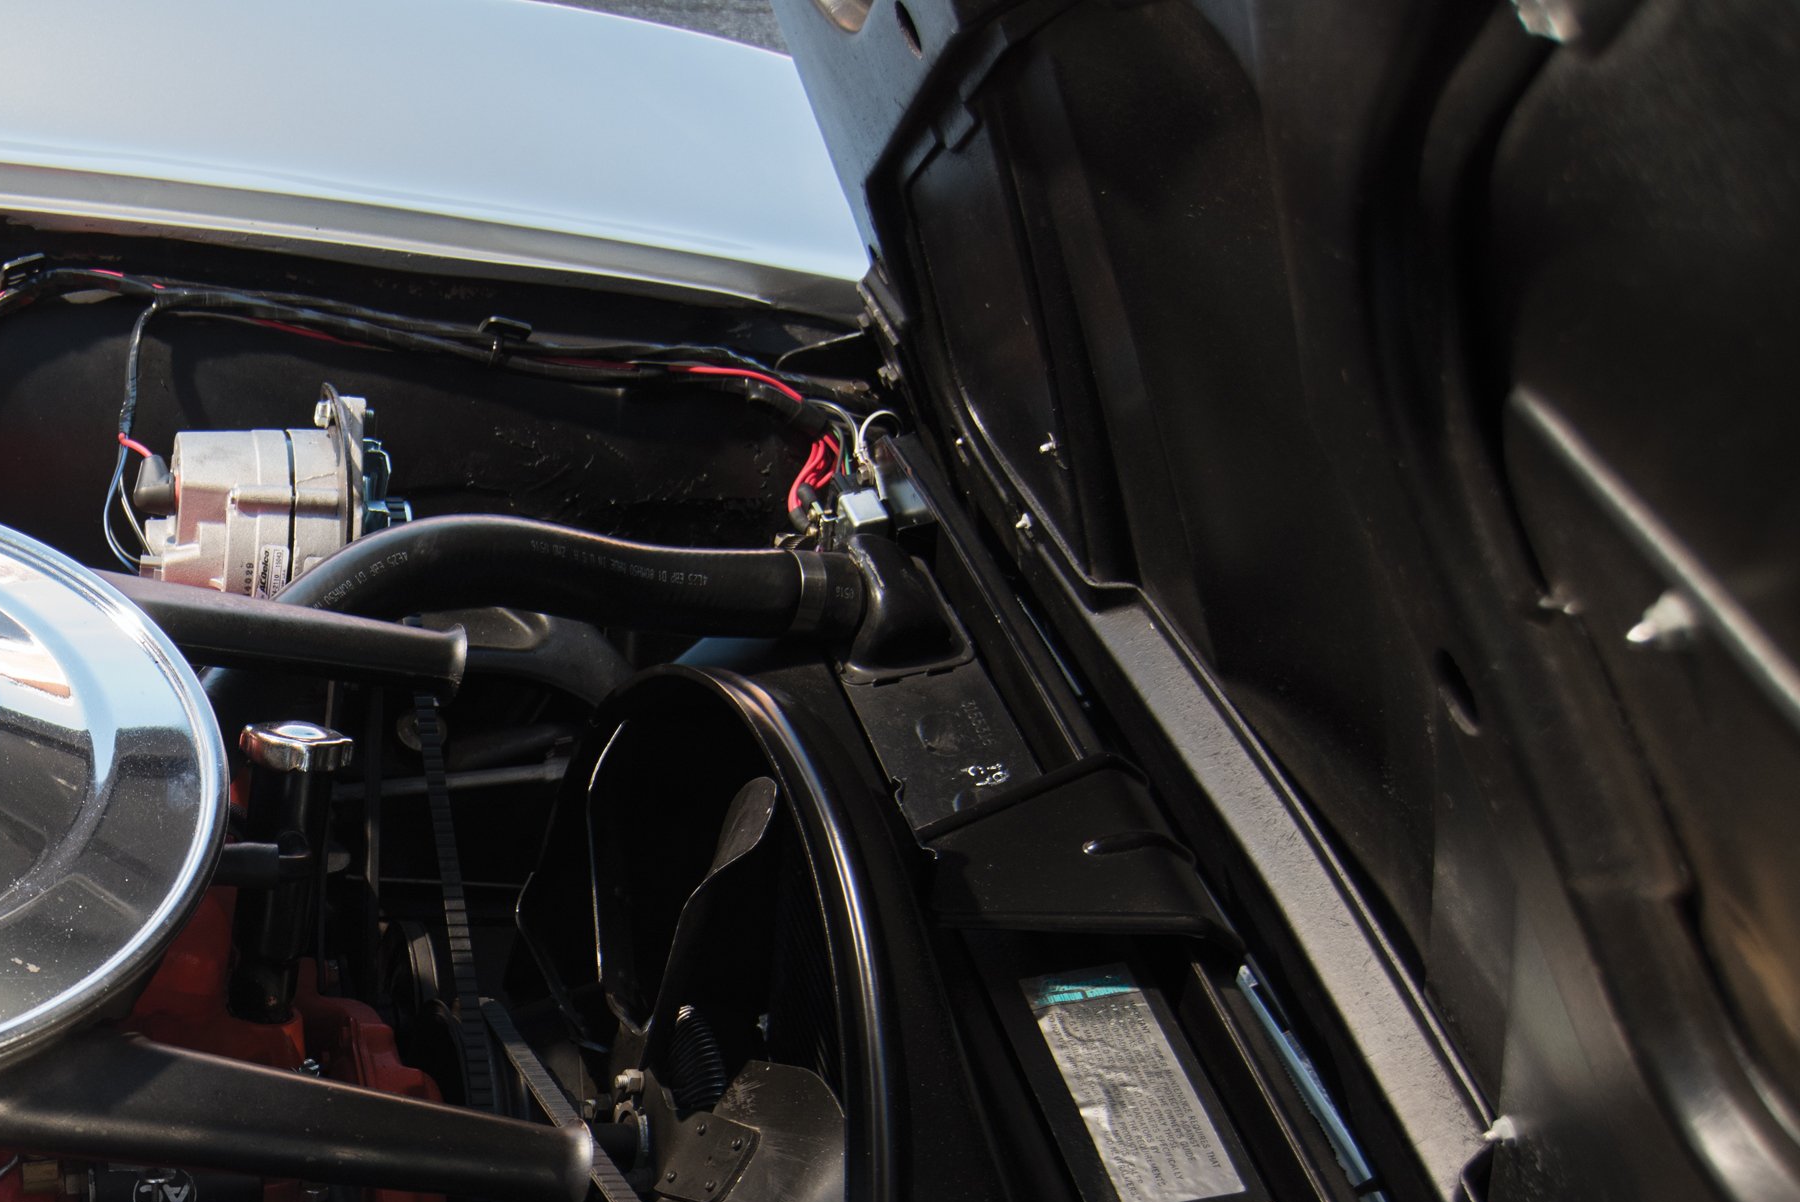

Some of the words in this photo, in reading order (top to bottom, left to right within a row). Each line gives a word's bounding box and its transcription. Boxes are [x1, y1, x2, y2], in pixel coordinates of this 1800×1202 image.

[1129, 1106, 1156, 1143] RADIATORS
[1136, 1099, 1161, 1133] CLEANERS
[1152, 1108, 1168, 1126] ONLY
[1158, 1081, 1186, 1118] PROTECTED
[1178, 1119, 1202, 1149] AGAINST
[1162, 1068, 1194, 1113] MAINTENANCE
[1186, 1115, 1213, 1148] REQUIRES
[1204, 1150, 1222, 1169] THAT
